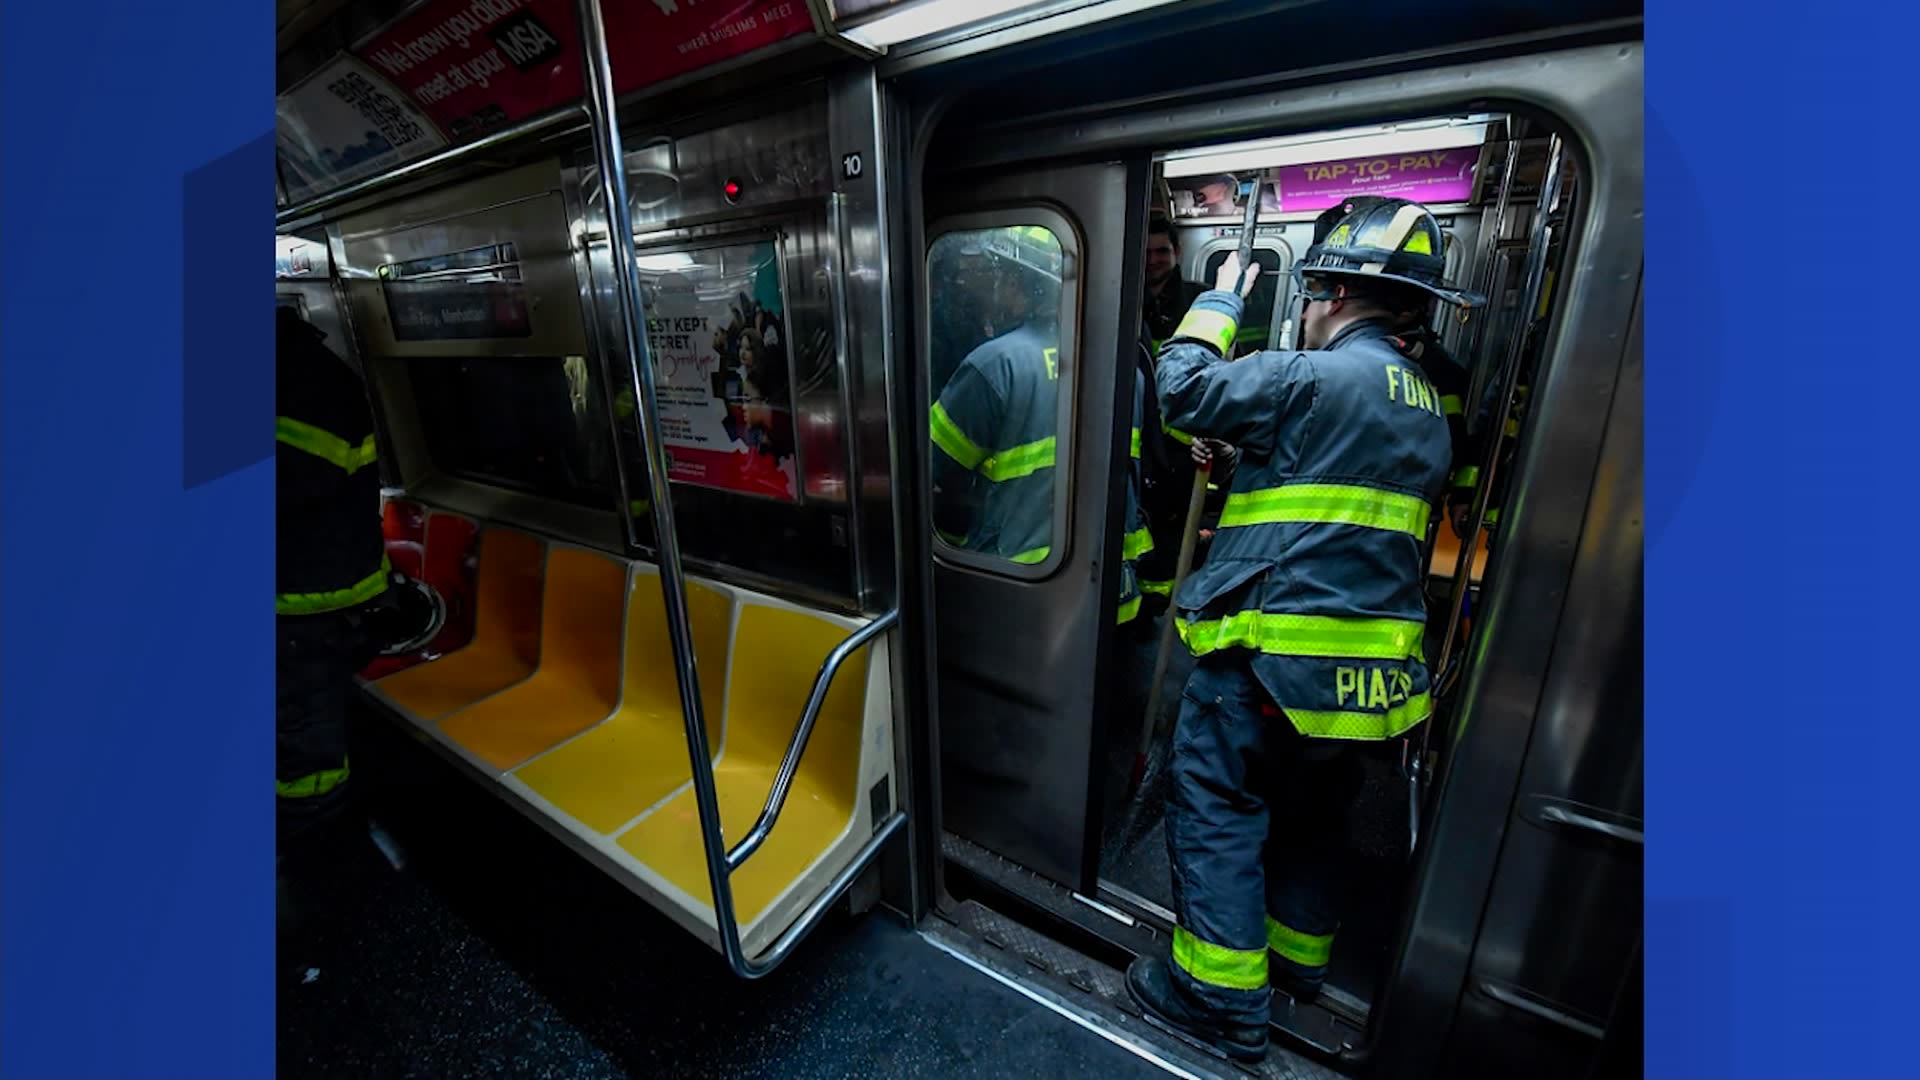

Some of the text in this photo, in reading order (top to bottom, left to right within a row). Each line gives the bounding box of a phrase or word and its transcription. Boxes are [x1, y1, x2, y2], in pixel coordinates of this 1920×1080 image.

[676, 3, 793, 54] WHERE MUSLIMS MEET
[370, 45, 414, 77] We
[392, 21, 452, 65] know
[438, 8, 491, 49] you
[412, 18, 557, 105] meet at your MSA
[844, 155, 861, 176] 10
[1304, 154, 1448, 181] TAP-TO-PAY
[1352, 173, 1391, 185] your fare
[647, 317, 708, 333] EST KEPT
[649, 335, 690, 349] ECRET
